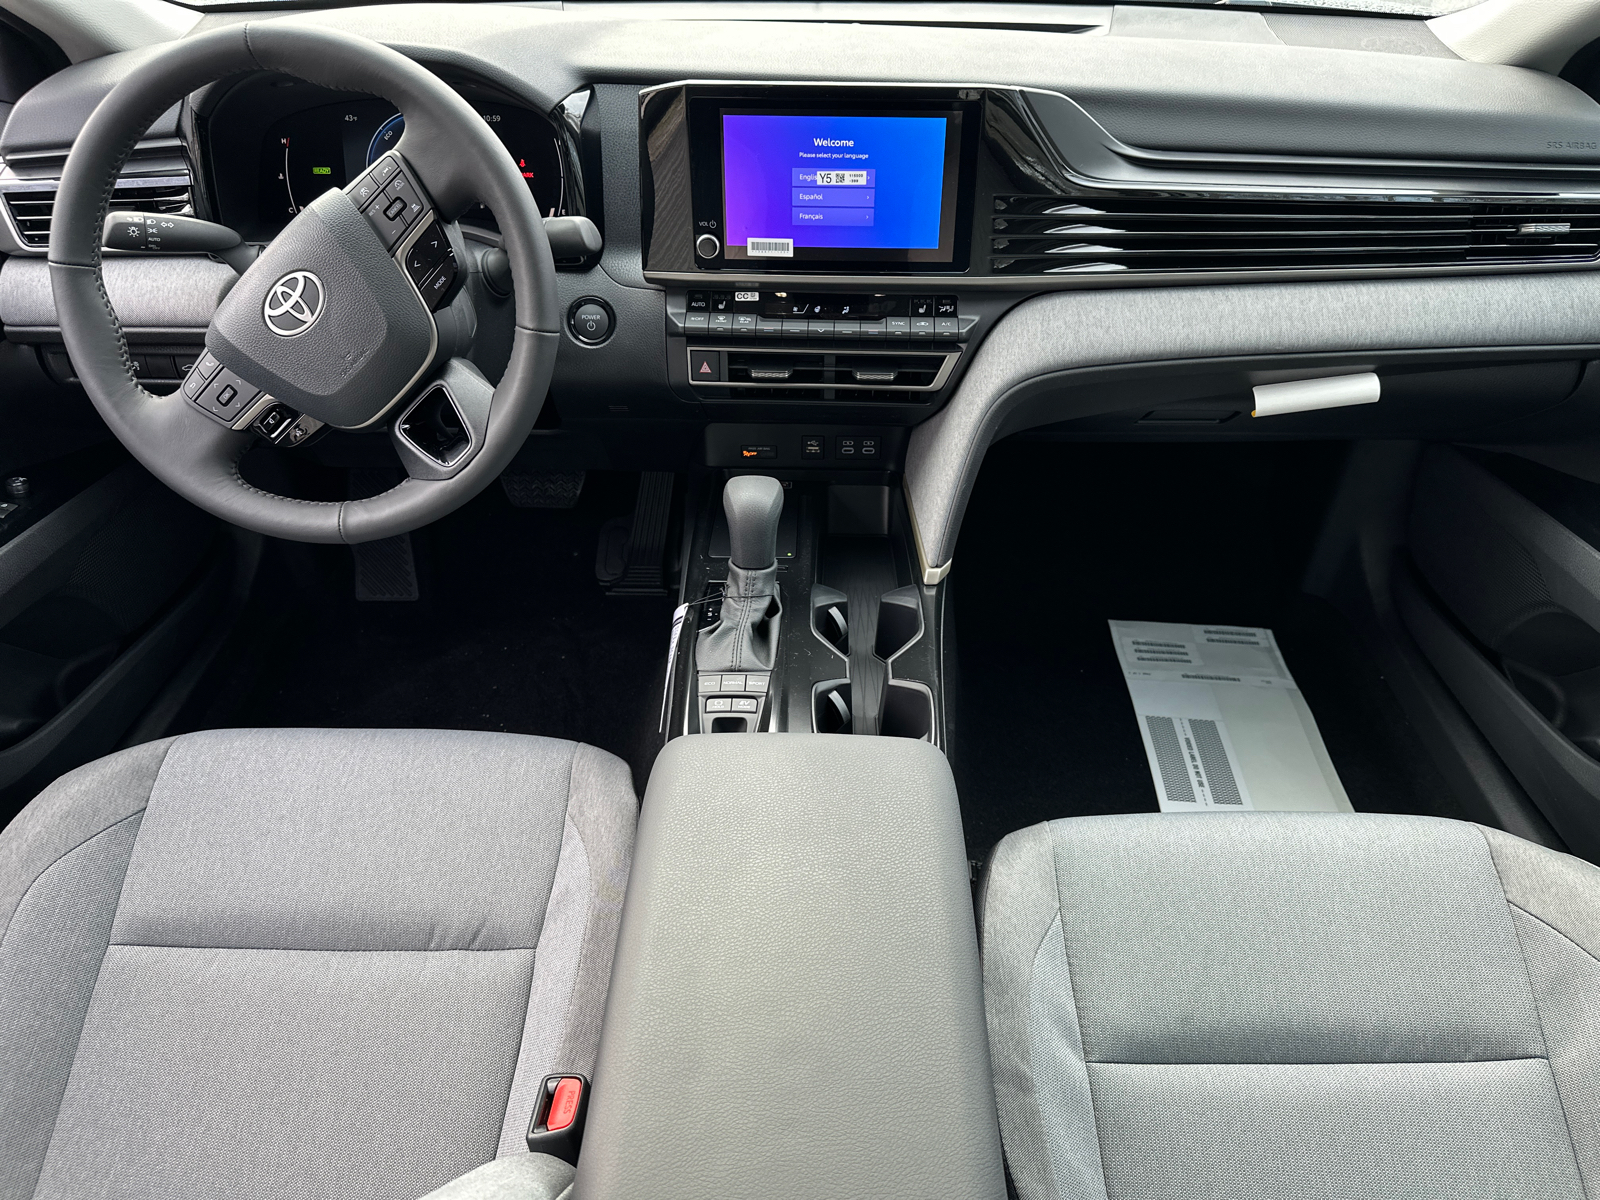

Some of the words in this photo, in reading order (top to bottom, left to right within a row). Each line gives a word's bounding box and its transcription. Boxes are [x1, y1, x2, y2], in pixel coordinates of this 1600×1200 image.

[383, 130, 394, 141] ECO
[813, 137, 855, 147] Welcome
[1546, 141, 1563, 149] SRS
[1566, 141, 1597, 150] AIRBAG
[799, 173, 818, 182] Englis
[819, 172, 832, 184] Y5
[799, 193, 823, 201] Español
[799, 212, 824, 220] Français
[433, 275, 447, 290] MODE
[736, 292, 749, 300] CC
[562, 1090, 576, 1115] PRESS
